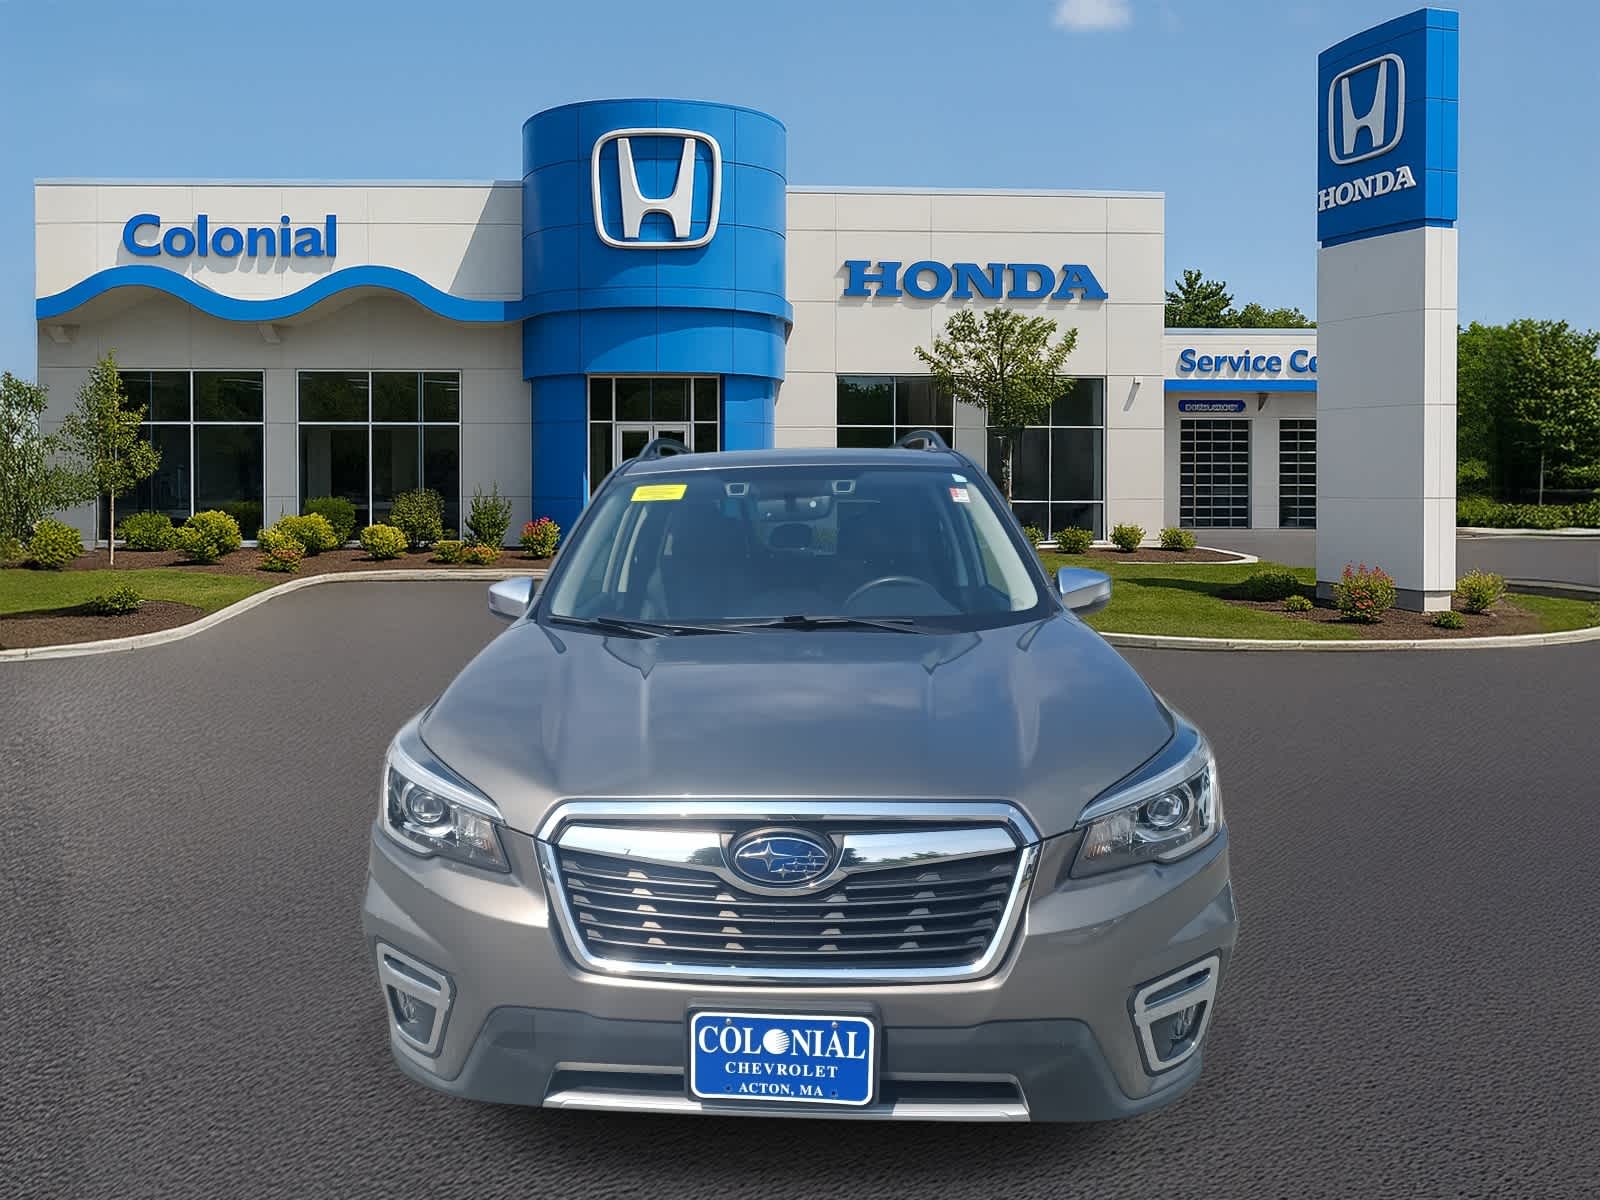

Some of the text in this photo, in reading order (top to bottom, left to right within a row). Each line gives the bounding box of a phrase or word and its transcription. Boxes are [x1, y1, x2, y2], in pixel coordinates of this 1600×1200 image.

[1318, 165, 1417, 212] HONDA
[122, 213, 337, 258] Colonial
[843, 260, 1109, 301] HONDA
[1180, 348, 1282, 373] Service
[725, 1061, 838, 1078] CHEVROLET
[738, 1082, 824, 1097] ACTON, MA
